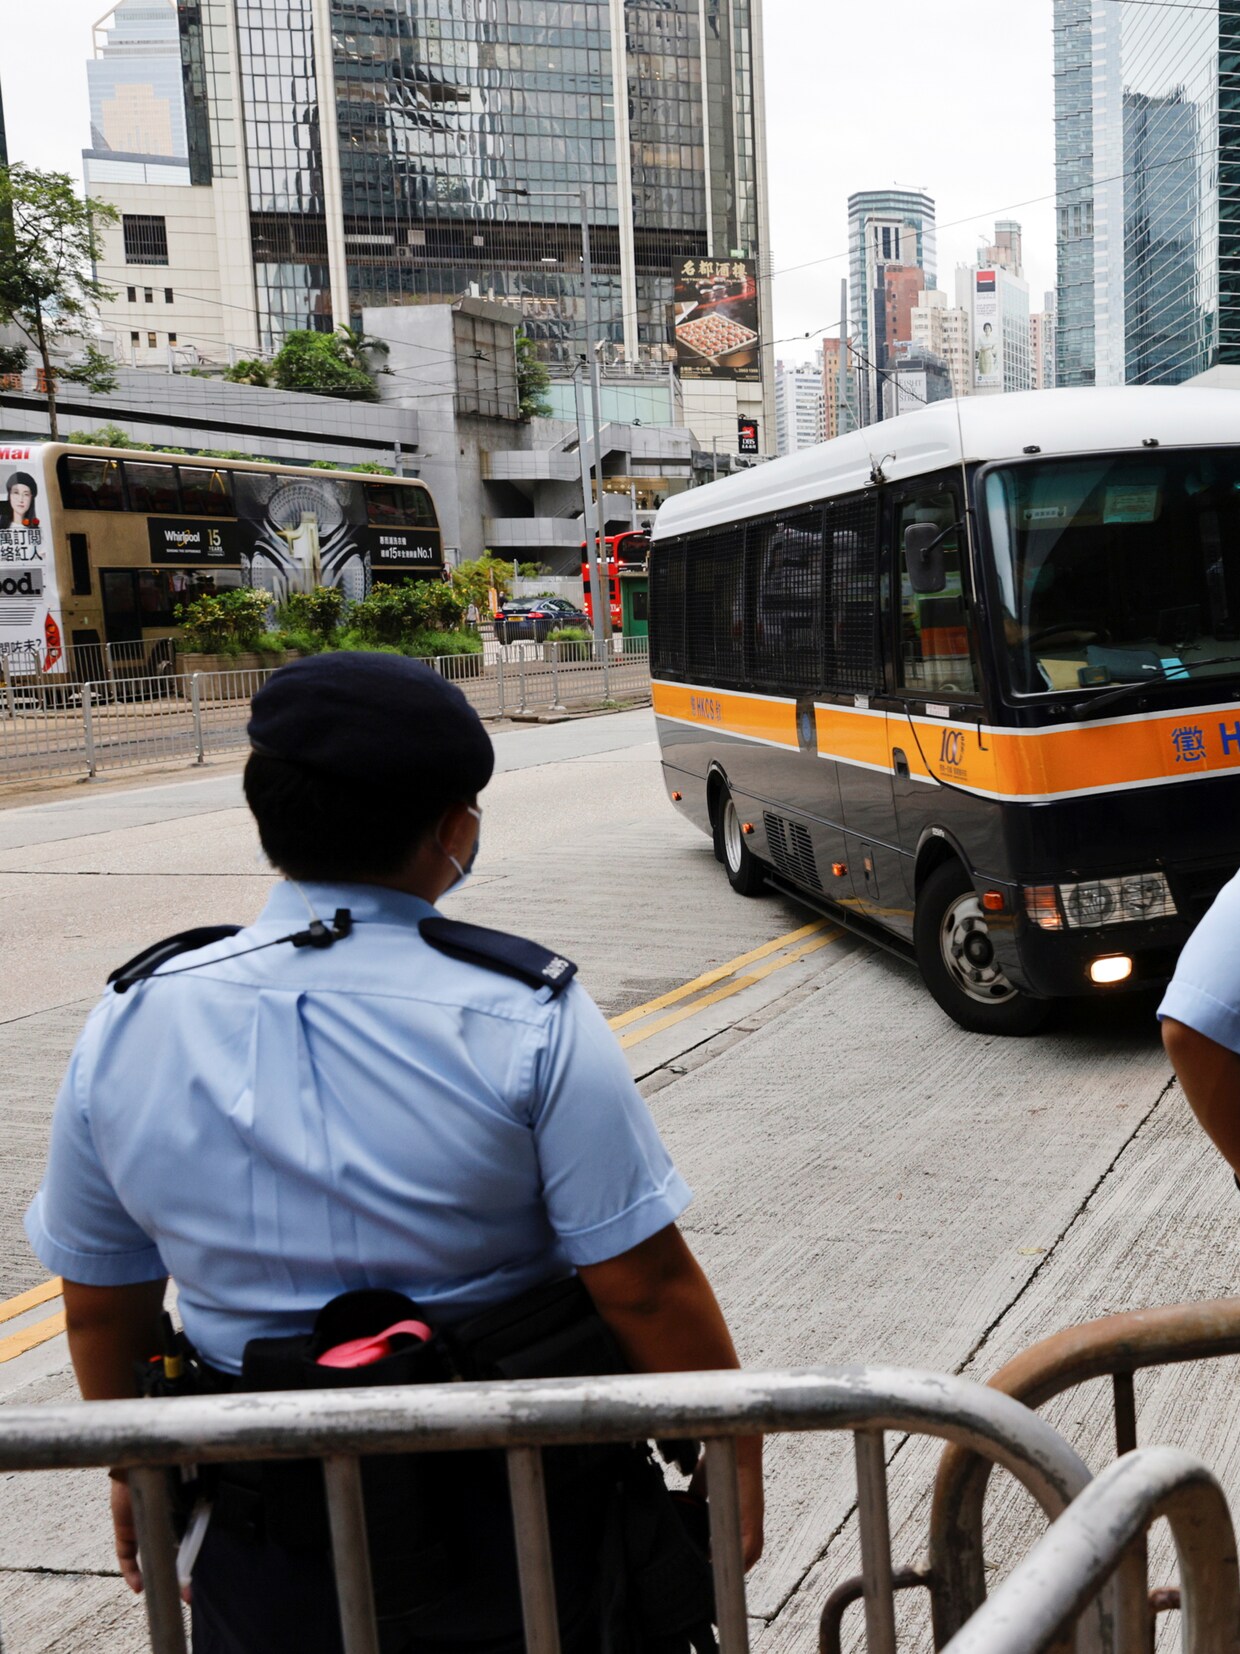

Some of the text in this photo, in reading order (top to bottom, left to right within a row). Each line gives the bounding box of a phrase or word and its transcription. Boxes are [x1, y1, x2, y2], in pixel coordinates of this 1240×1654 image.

[681, 260, 747, 279] 名都酒樓
[164, 528, 222, 547] Whirlpool 15
[0, 571, 41, 595] od.
[697, 696, 715, 720] HKCS
